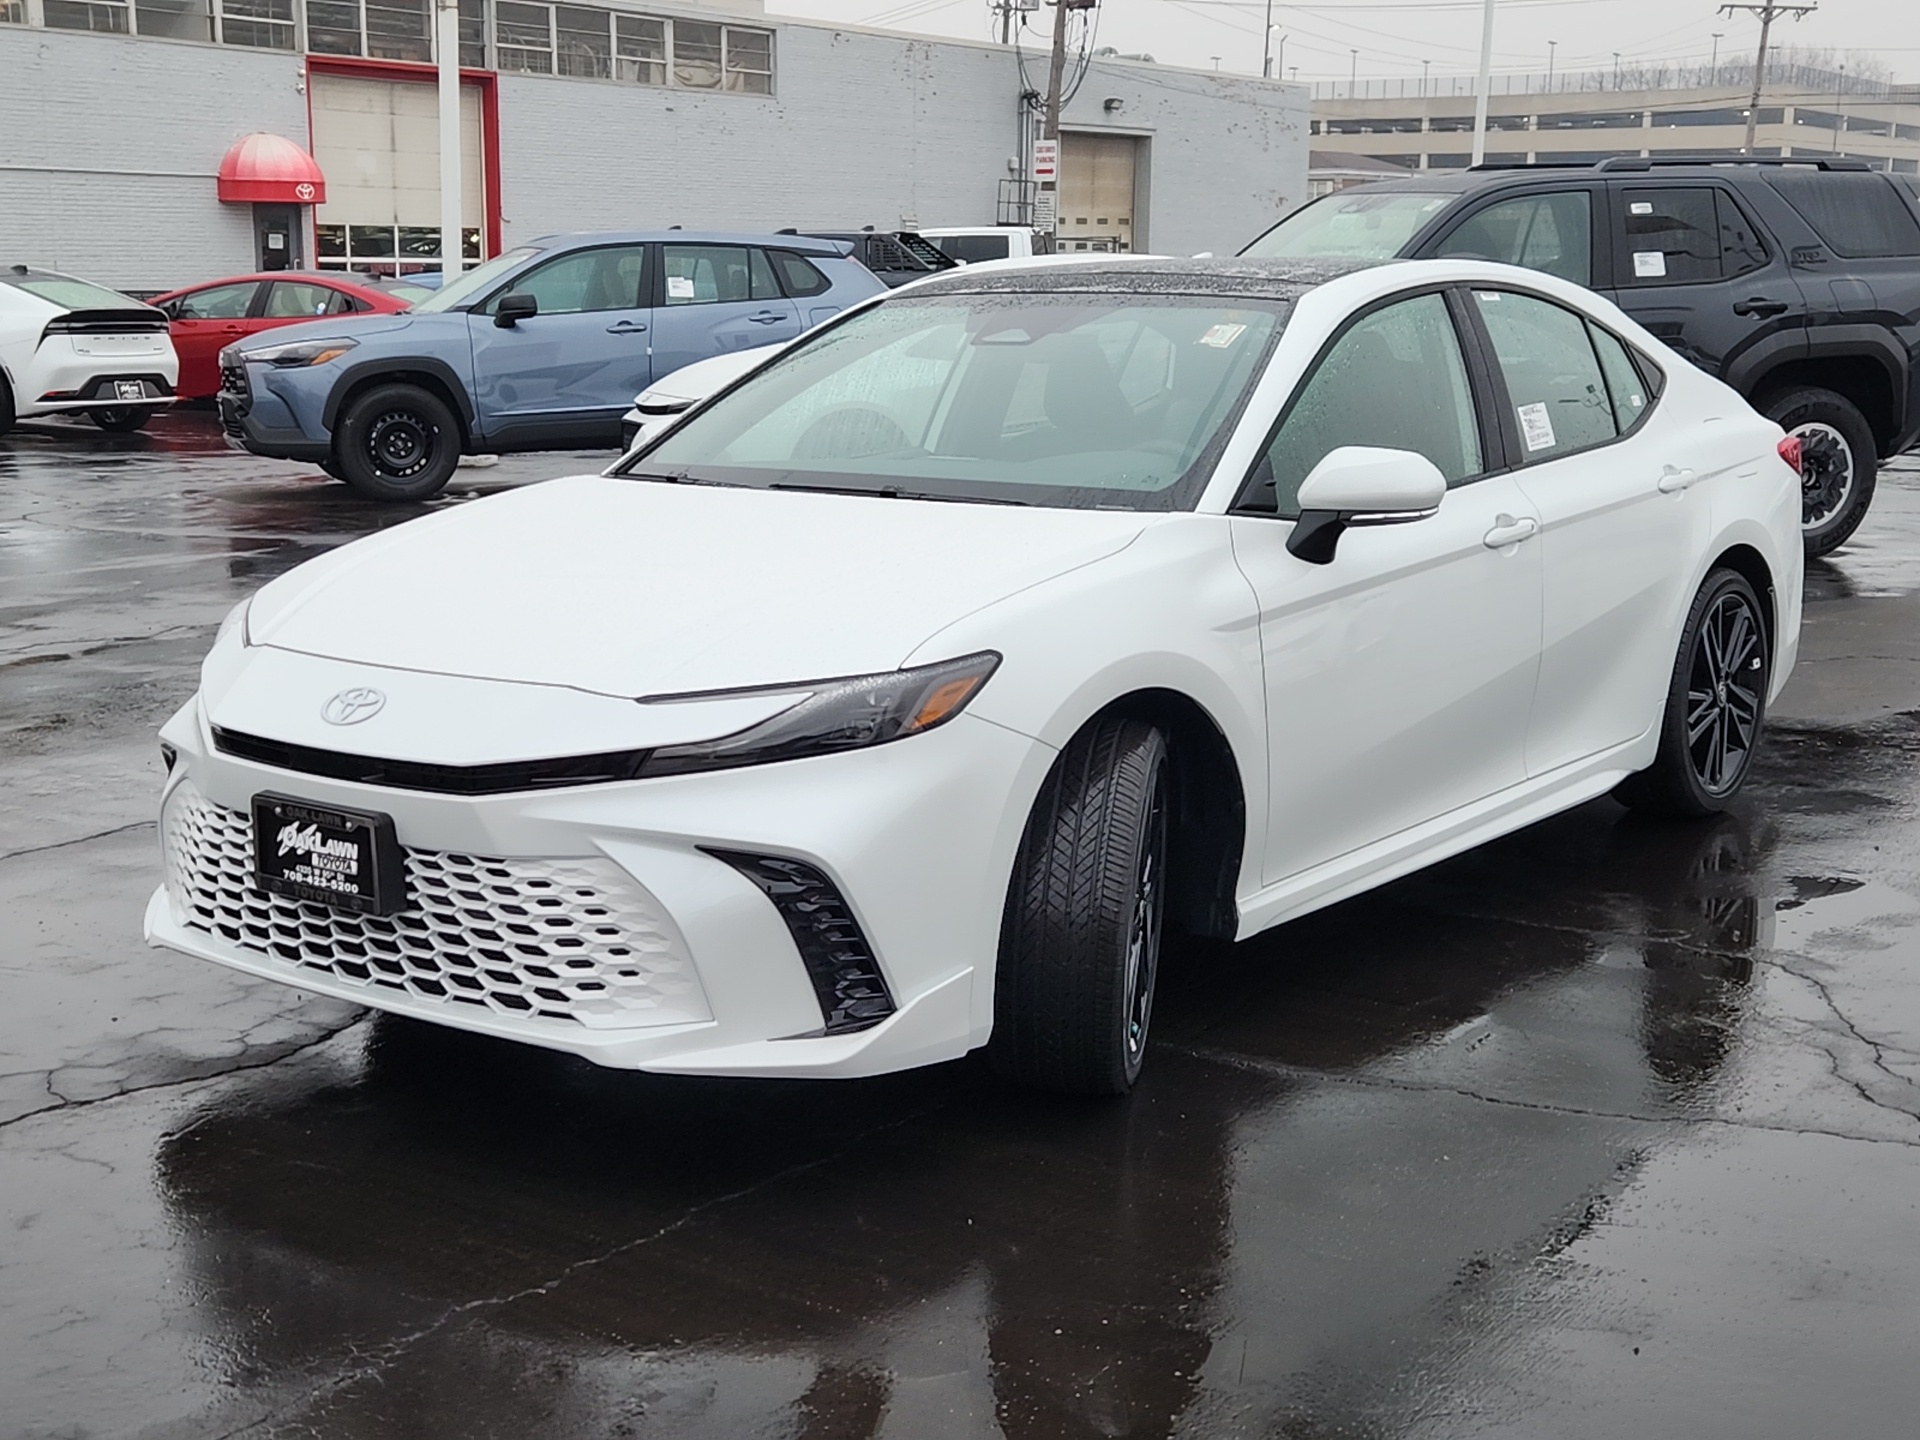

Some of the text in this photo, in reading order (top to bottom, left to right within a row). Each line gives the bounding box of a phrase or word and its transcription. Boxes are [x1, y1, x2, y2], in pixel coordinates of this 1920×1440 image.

[286, 806, 342, 826] OAK LAWN
[316, 855, 353, 872] TOYOTA
[294, 884, 338, 905] TOYOTA
